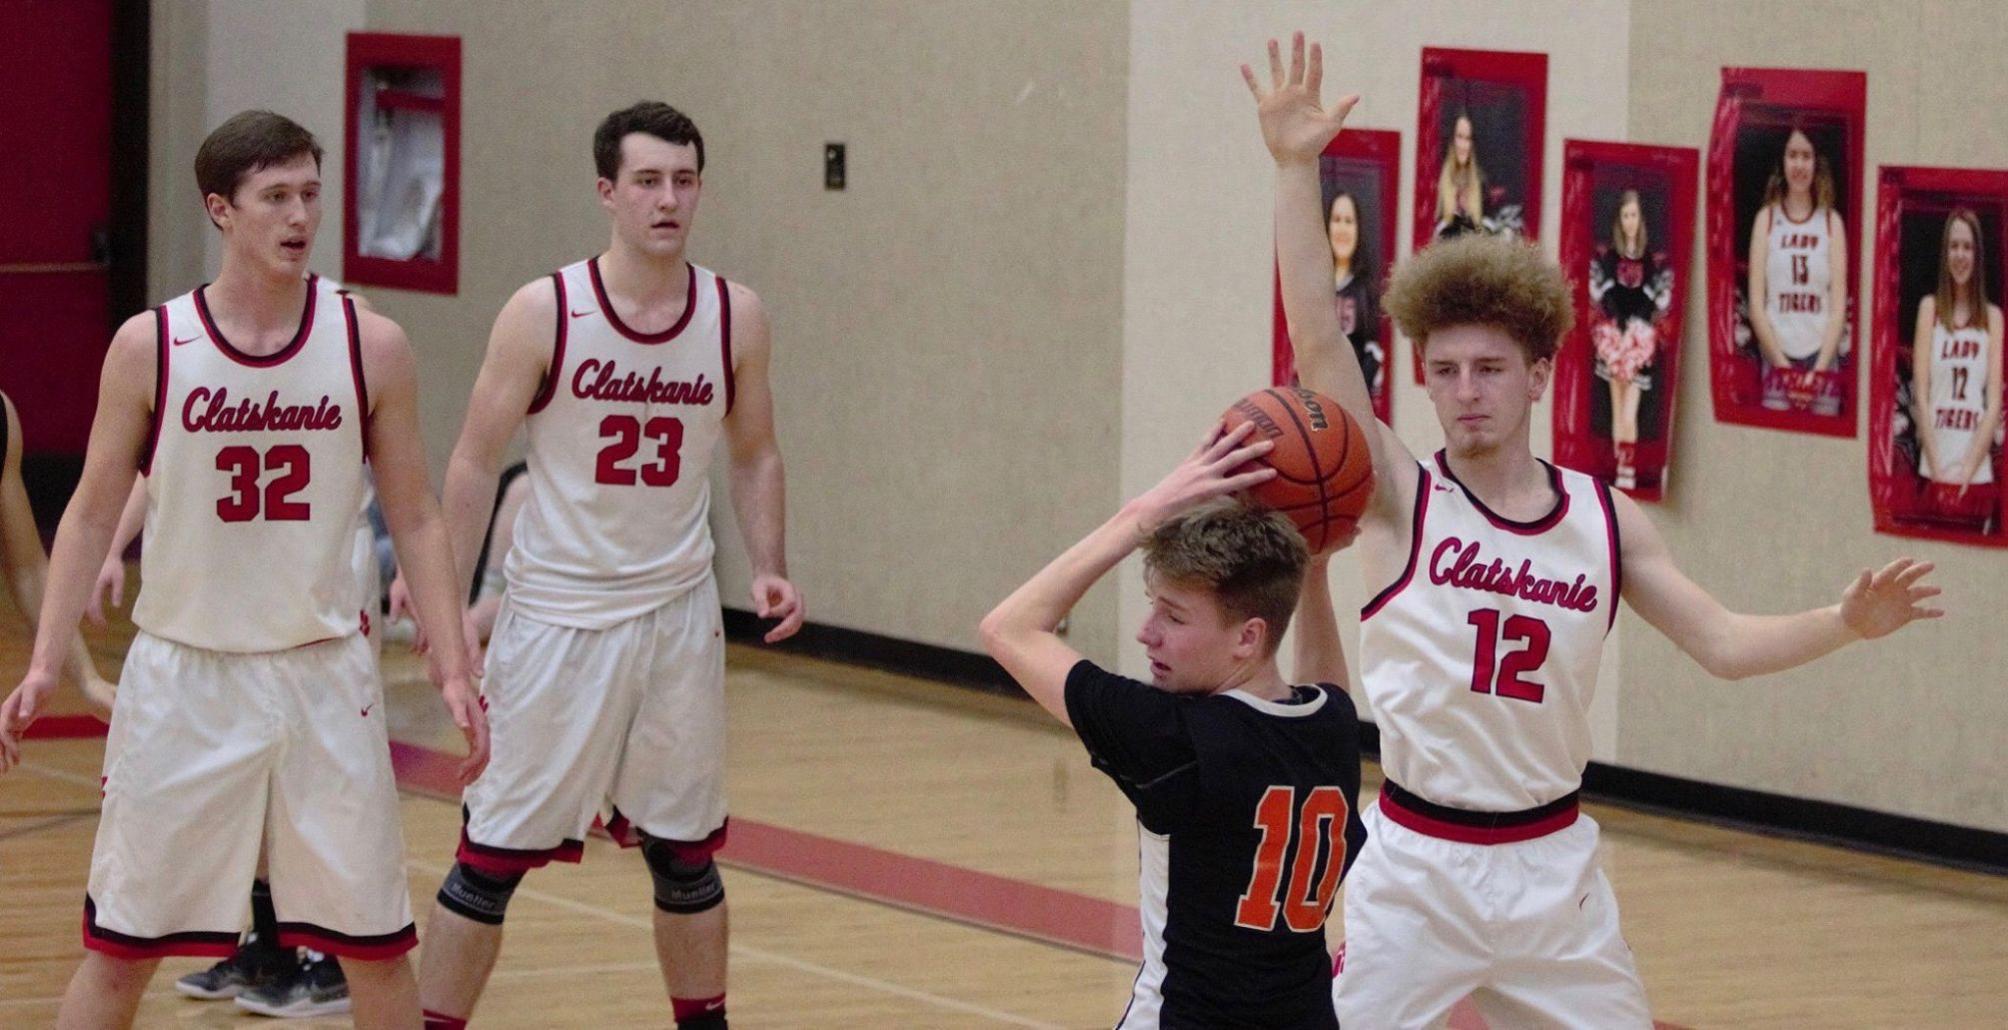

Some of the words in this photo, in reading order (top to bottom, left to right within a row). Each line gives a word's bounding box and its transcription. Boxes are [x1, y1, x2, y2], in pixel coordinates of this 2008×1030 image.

[1780, 234, 1820, 249] LADY
[1791, 253, 1809, 286] 13
[1778, 292, 1822, 315] TIGERS
[1940, 339, 1980, 360] LADY
[572, 358, 714, 406] Clatskanie
[1951, 366, 1969, 400] 12
[181, 386, 342, 433] Clatskanie
[1934, 407, 1980, 431] TIGERS
[595, 414, 684, 487] 23
[215, 444, 311, 523] 32
[1429, 536, 1598, 613] Clatskanie
[1467, 607, 1552, 704] 12
[1234, 785, 1350, 933] 10
